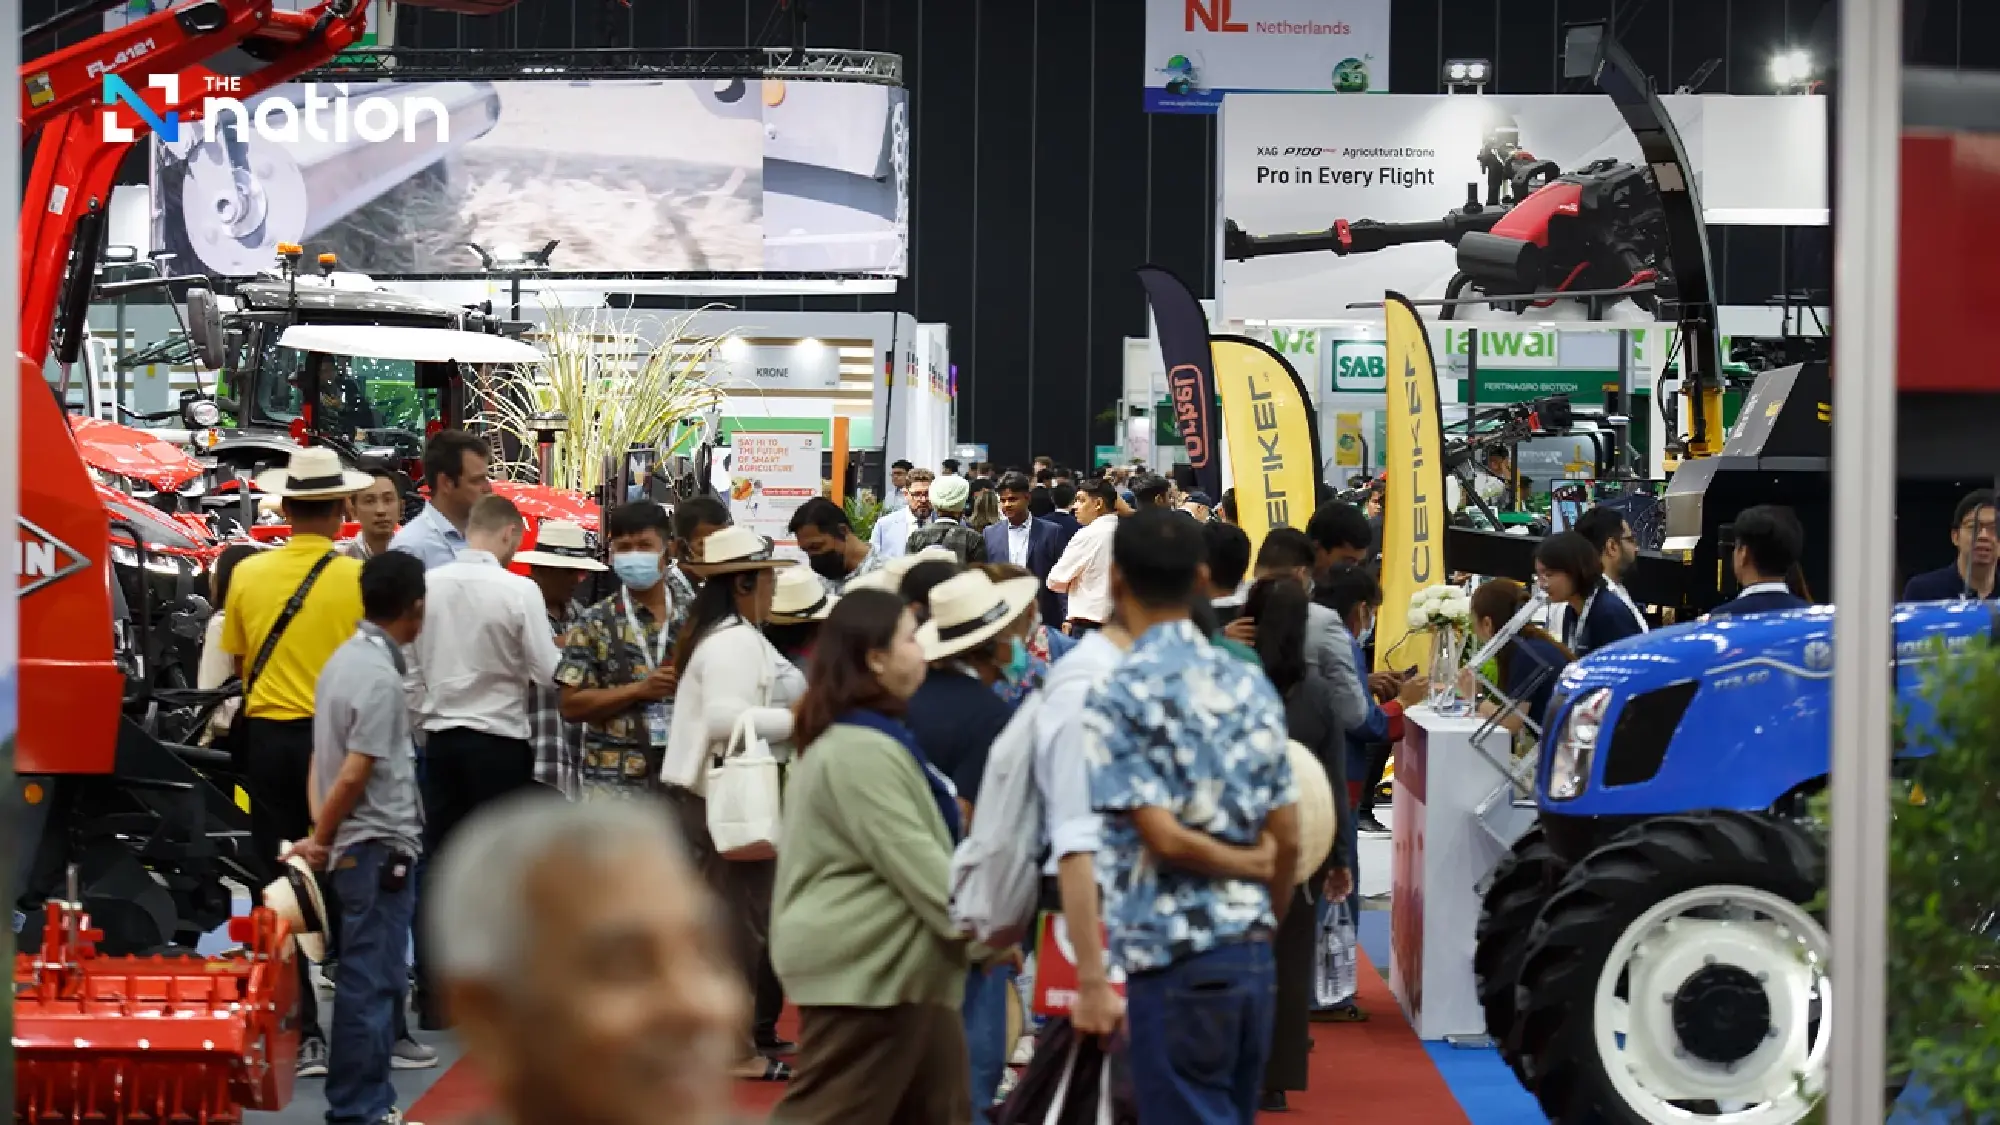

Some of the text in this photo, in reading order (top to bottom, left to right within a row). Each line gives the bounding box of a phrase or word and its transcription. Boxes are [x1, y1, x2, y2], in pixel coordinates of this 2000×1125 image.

[1185, 0, 1248, 33] NL
[1256, 20, 1351, 35] Netherlands
[1257, 147, 1278, 156] XAG
[1343, 147, 1403, 159] Agricultural
[1406, 147, 1435, 157] Drone
[1257, 166, 1435, 188] Pro in Every Flight
[756, 368, 789, 378] KRONE
[1339, 356, 1386, 377] SAB
[1540, 382, 1578, 391] BIOTECH
[739, 447, 789, 455] THE FUTURE
